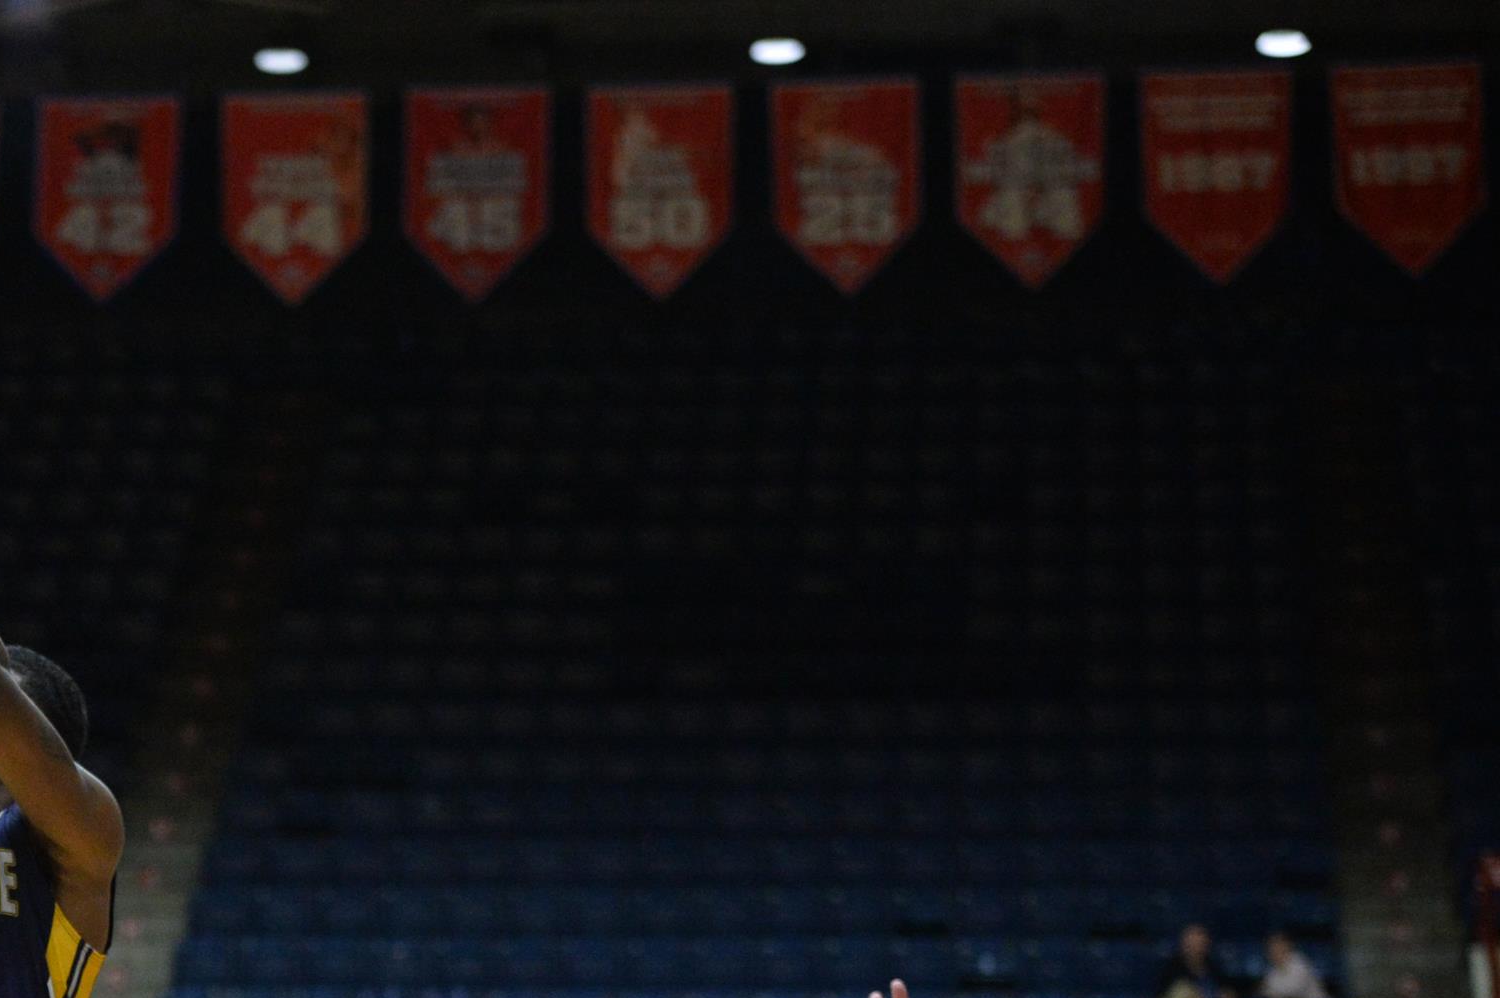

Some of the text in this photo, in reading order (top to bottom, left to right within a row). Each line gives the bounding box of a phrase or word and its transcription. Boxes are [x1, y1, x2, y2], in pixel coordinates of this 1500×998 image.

[55, 203, 156, 257] 42
[238, 202, 345, 259] 44
[425, 199, 526, 256] 45
[607, 195, 712, 251] 50
